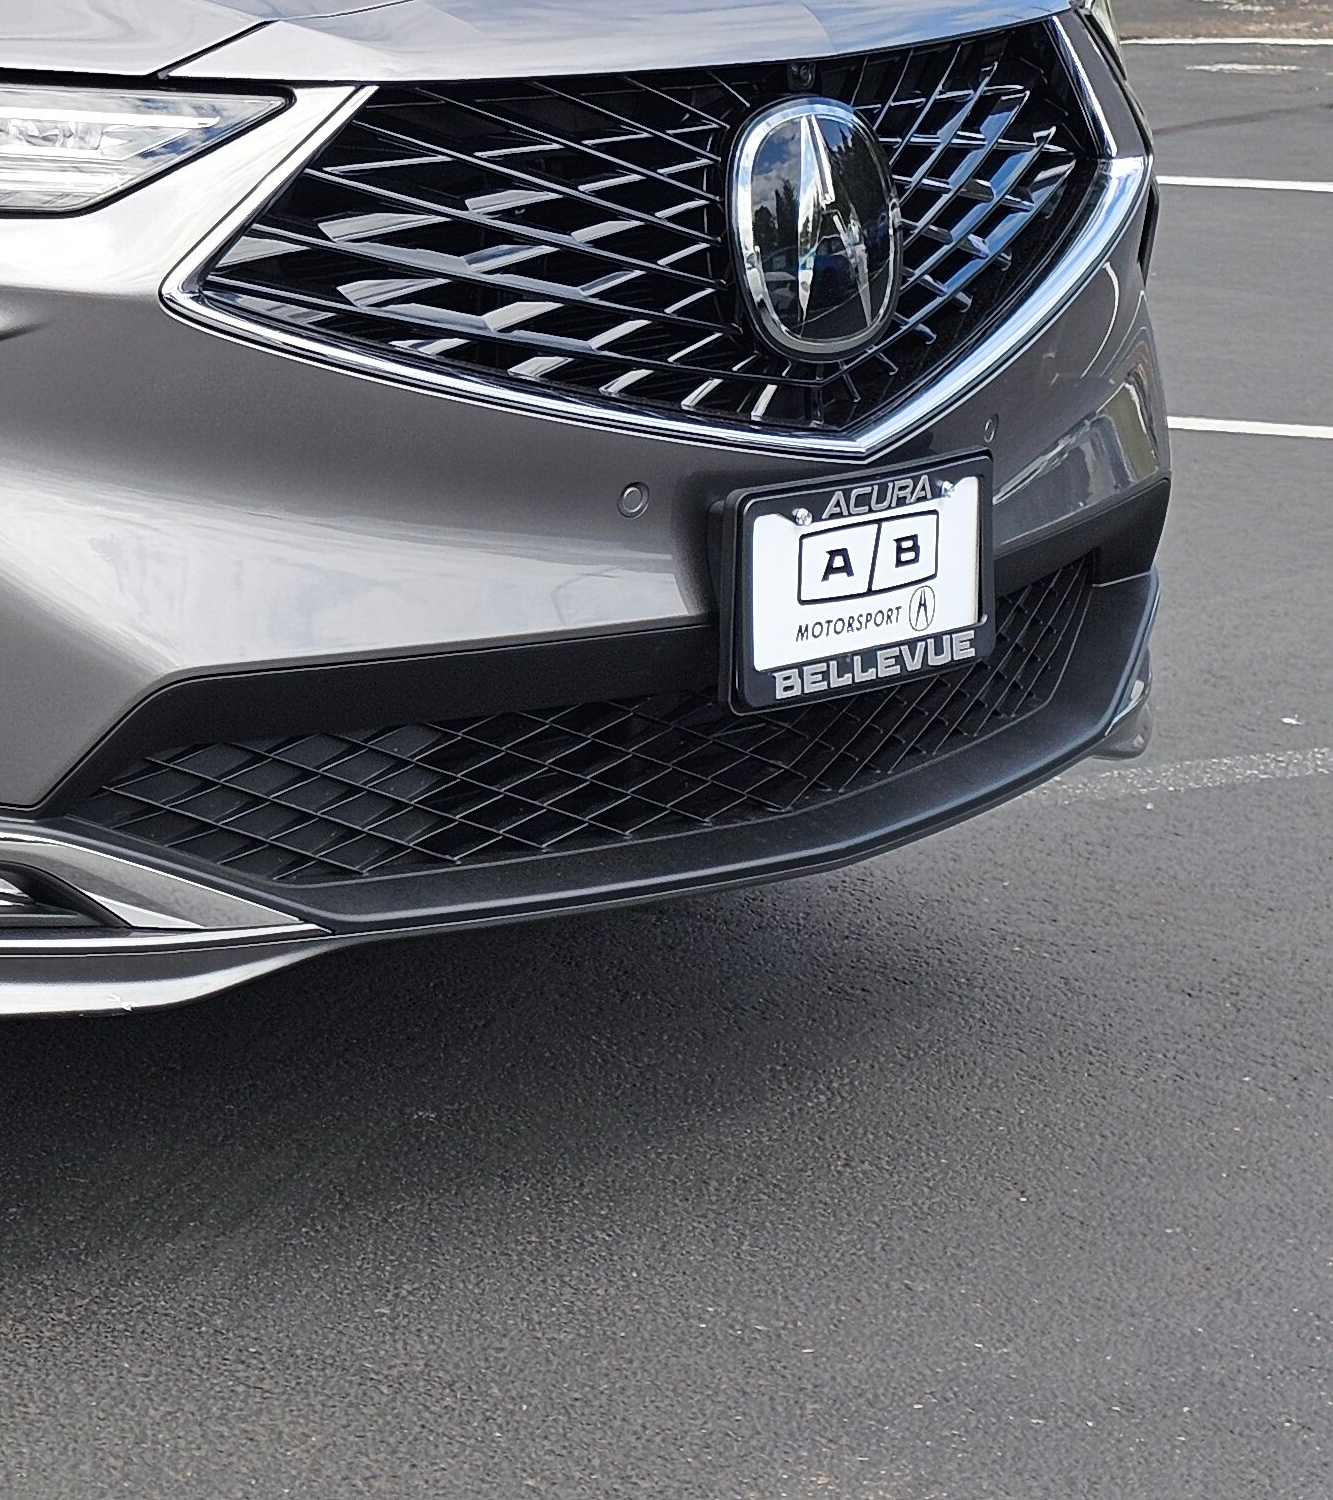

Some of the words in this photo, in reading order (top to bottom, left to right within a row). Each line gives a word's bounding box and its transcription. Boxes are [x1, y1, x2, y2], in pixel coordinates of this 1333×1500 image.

[821, 474, 933, 520] ACURA
[820, 547, 855, 582] A
[892, 533, 921, 568] B
[795, 605, 903, 643] MOTORSPORT
[771, 629, 976, 700] BELLEVUE
